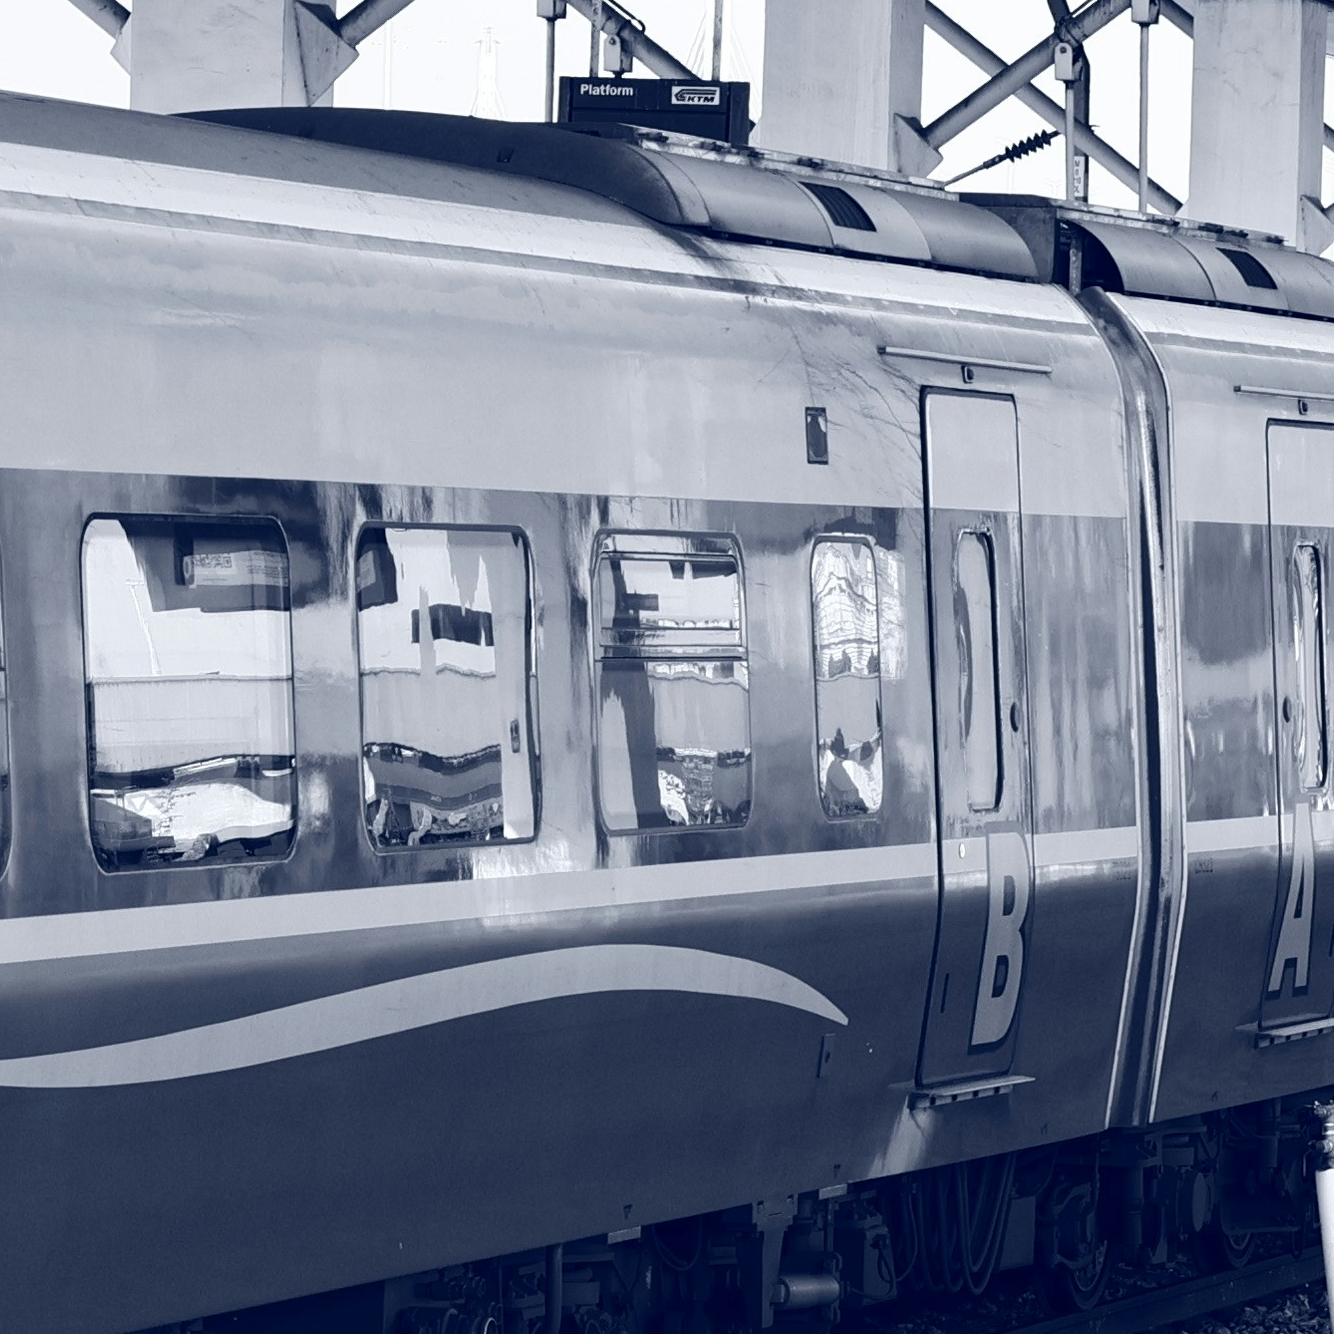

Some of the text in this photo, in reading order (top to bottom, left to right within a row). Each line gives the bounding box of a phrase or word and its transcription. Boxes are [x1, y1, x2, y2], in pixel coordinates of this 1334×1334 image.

[580, 83, 634, 97] Platform
[970, 830, 1030, 1047] B
[1268, 803, 1314, 992] A
